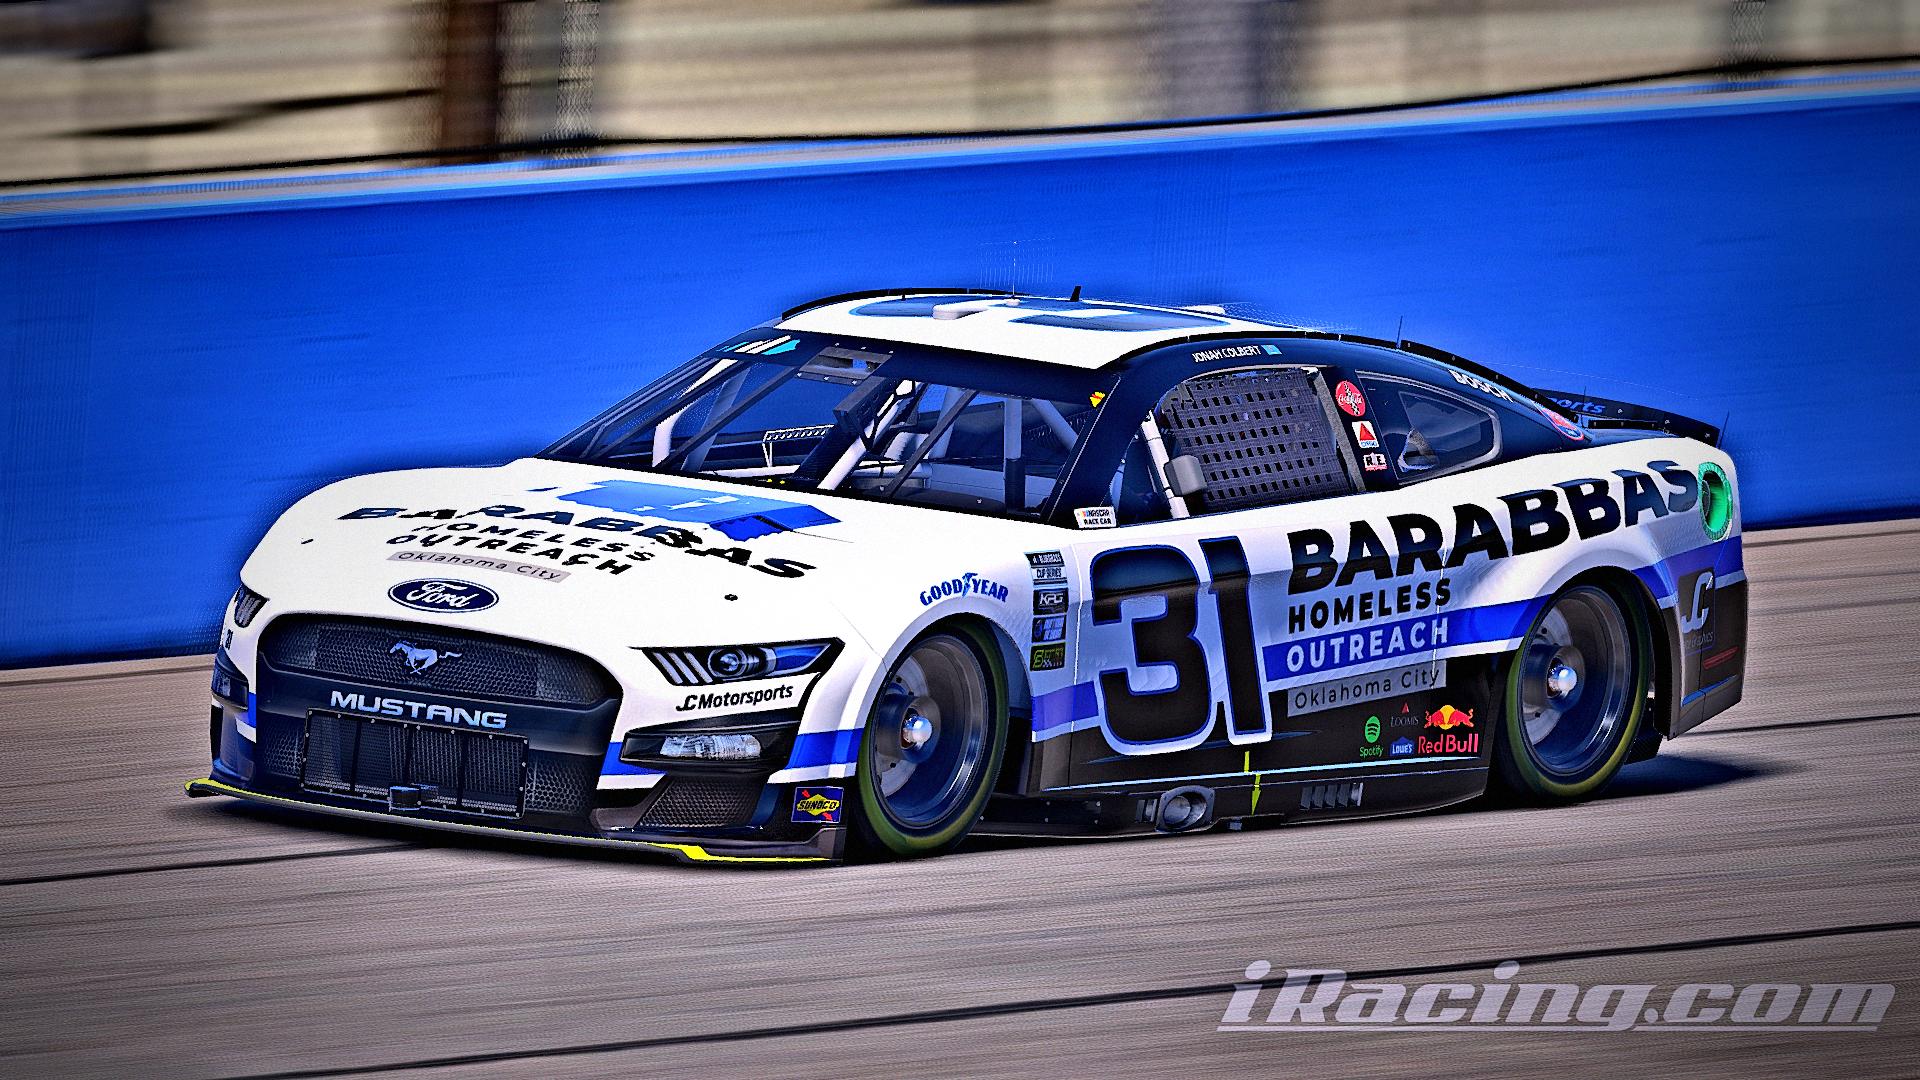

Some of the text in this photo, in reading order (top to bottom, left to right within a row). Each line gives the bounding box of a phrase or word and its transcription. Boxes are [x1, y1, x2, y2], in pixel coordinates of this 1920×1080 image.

[1192, 345, 1261, 362] JONAH COLBERT
[337, 505, 817, 578] BARABBAS
[411, 522, 655, 562] HOMELESS
[1287, 461, 1698, 595] BARABBAS
[386, 534, 632, 576] OUTREACH
[398, 551, 562, 581] Oklahoma City
[406, 582, 479, 608] Ford
[919, 572, 1009, 606] GOODYEAR
[1288, 578, 1451, 634] HOMELESS
[1090, 536, 1267, 745] 31
[1286, 617, 1449, 673] OUTREACH
[1294, 668, 1440, 709] Oklahoma City
[330, 690, 508, 729] MUSTANG
[1359, 745, 1384, 758] Spotify
[1418, 733, 1479, 753] Red Bull
[798, 799, 838, 811] SUNOCO
